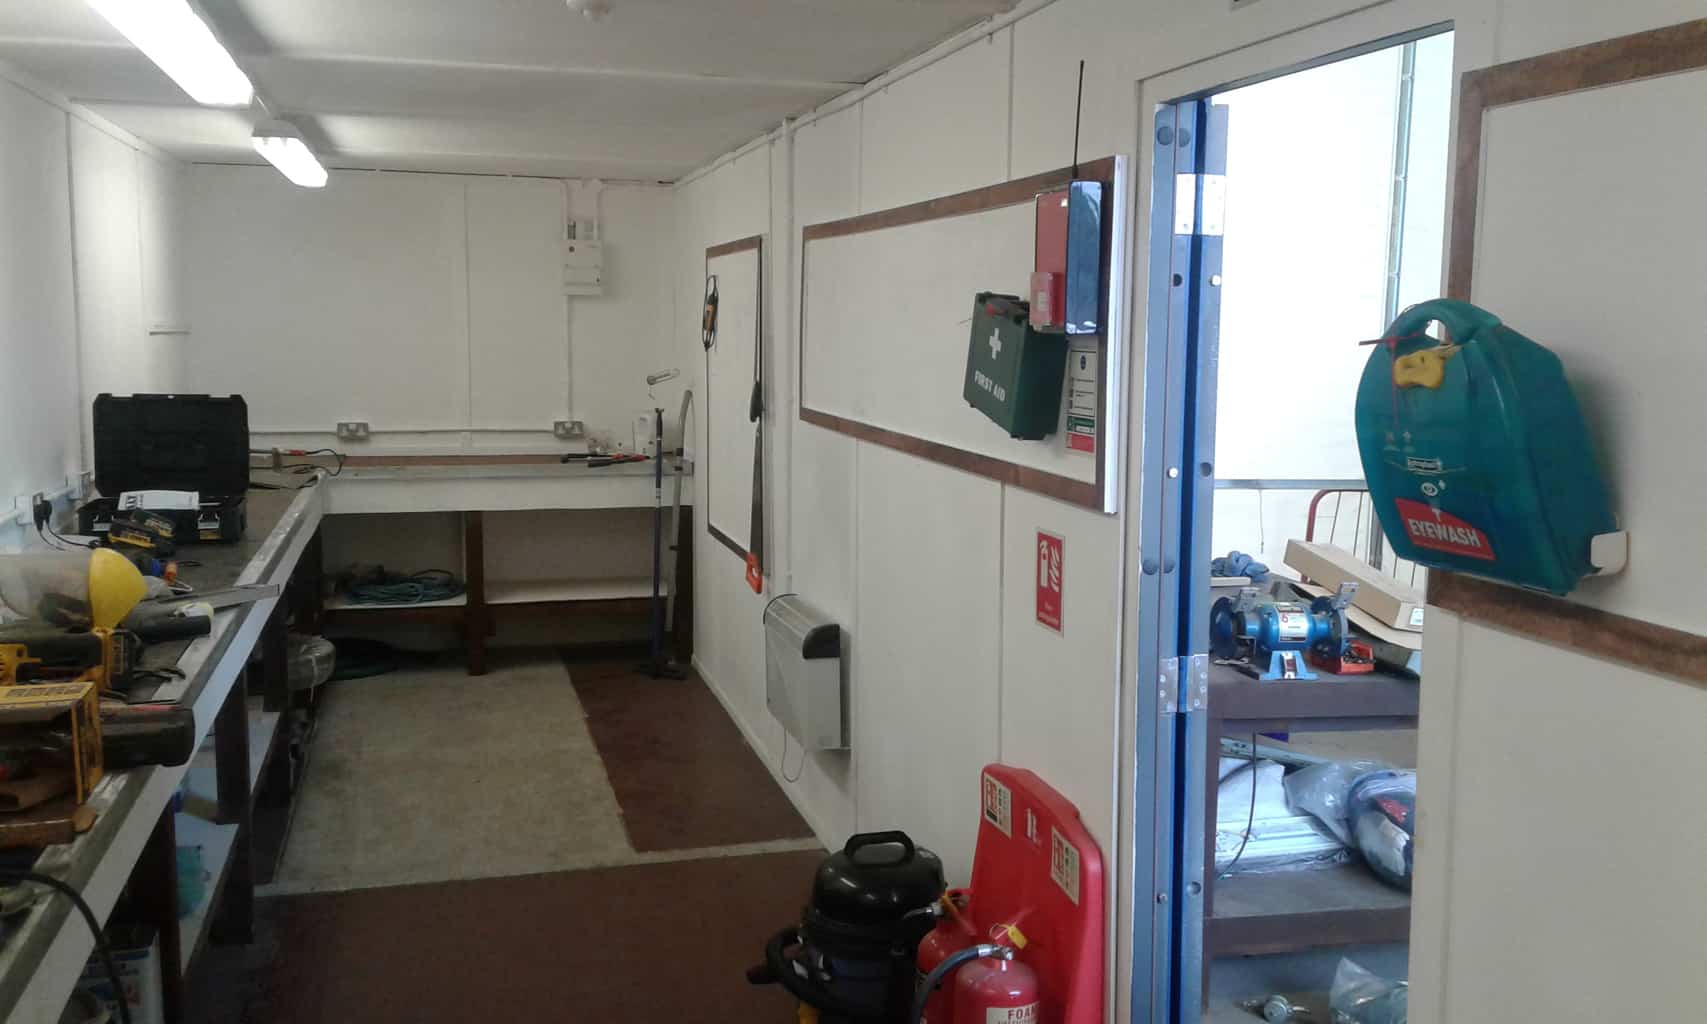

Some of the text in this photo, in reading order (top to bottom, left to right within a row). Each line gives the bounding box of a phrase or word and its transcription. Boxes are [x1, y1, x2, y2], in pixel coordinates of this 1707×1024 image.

[974, 370, 1006, 402] FIRST AID
[1408, 519, 1480, 547] EYEWASH
